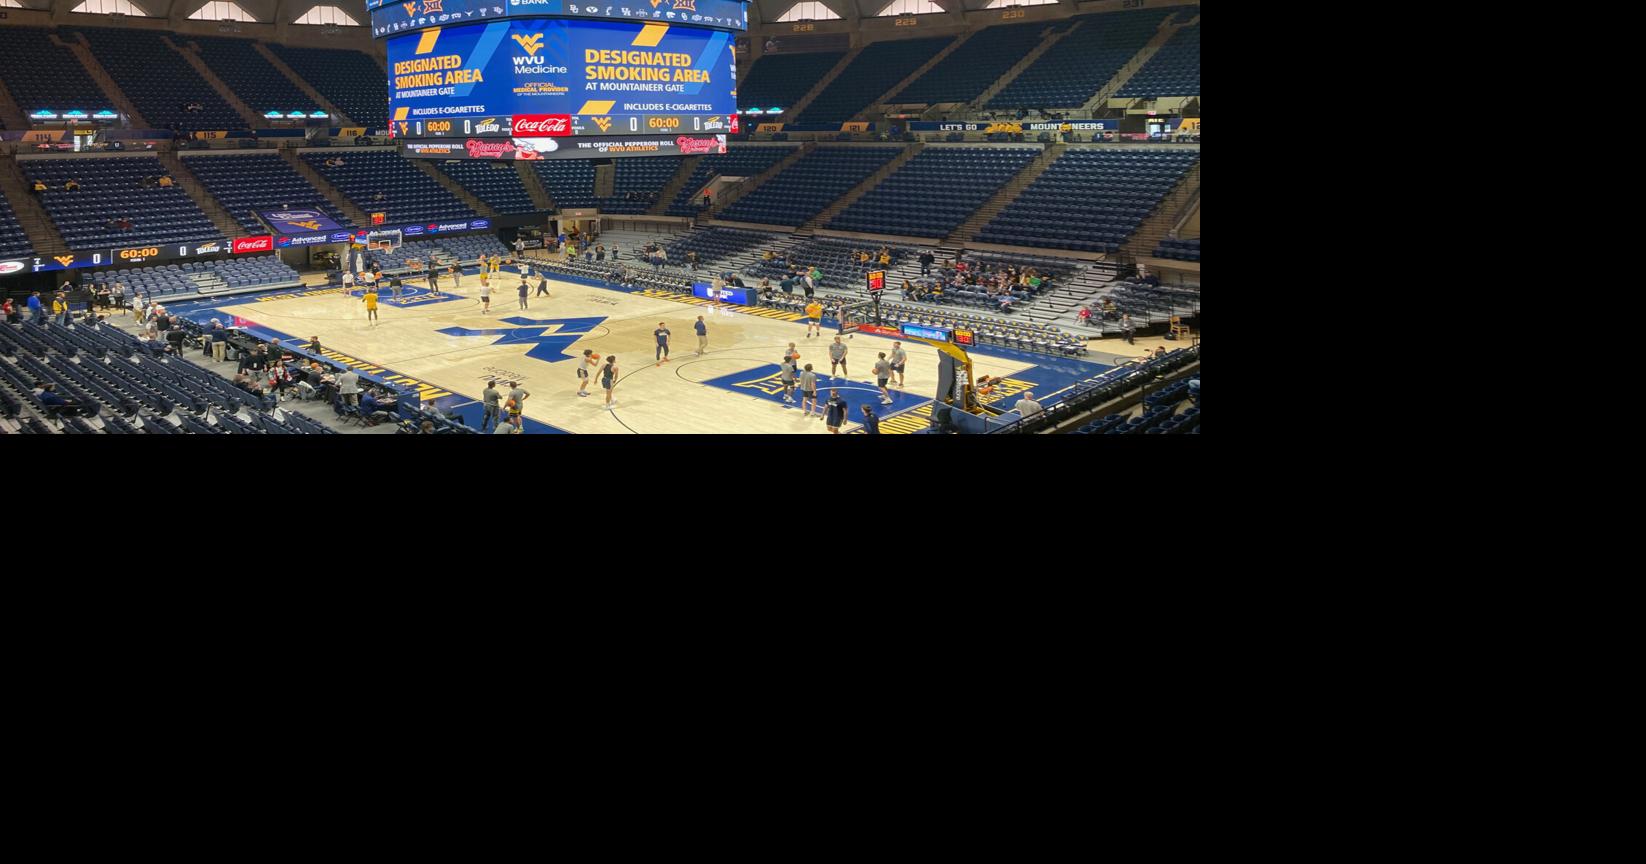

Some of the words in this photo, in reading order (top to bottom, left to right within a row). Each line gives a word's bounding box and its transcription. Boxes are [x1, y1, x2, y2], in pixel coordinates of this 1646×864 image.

[394, 54, 462, 75] DESIGNATED
[512, 56, 544, 65] WVU
[585, 49, 691, 67] DESIGNATED
[514, 65, 567, 74] Medicine
[585, 66, 670, 82] SMOKING
[673, 70, 710, 83] AREA
[395, 72, 447, 90] SMOKING
[445, 69, 483, 84] AREA
[401, 88, 438, 98] MOUNTAINEER
[438, 87, 455, 96] GATE
[585, 82, 598, 91] AT
[600, 83, 663, 92] MOUNTAINEER
[665, 84, 684, 92] GATE
[413, 107, 438, 115] INCLUDES
[439, 105, 485, 114] E-CIGARETTES
[427, 121, 450, 132] 60:00
[464, 120, 470, 134] 0
[514, 118, 567, 133] Coca-Cola
[630, 117, 637, 132] 0
[649, 118, 679, 128] 60:00
[694, 117, 700, 131] 0
[238, 239, 268, 249] Coca-Cola
[93, 254, 100, 264] 0
[120, 248, 158, 258] 60:00
[180, 246, 186, 256] 0
